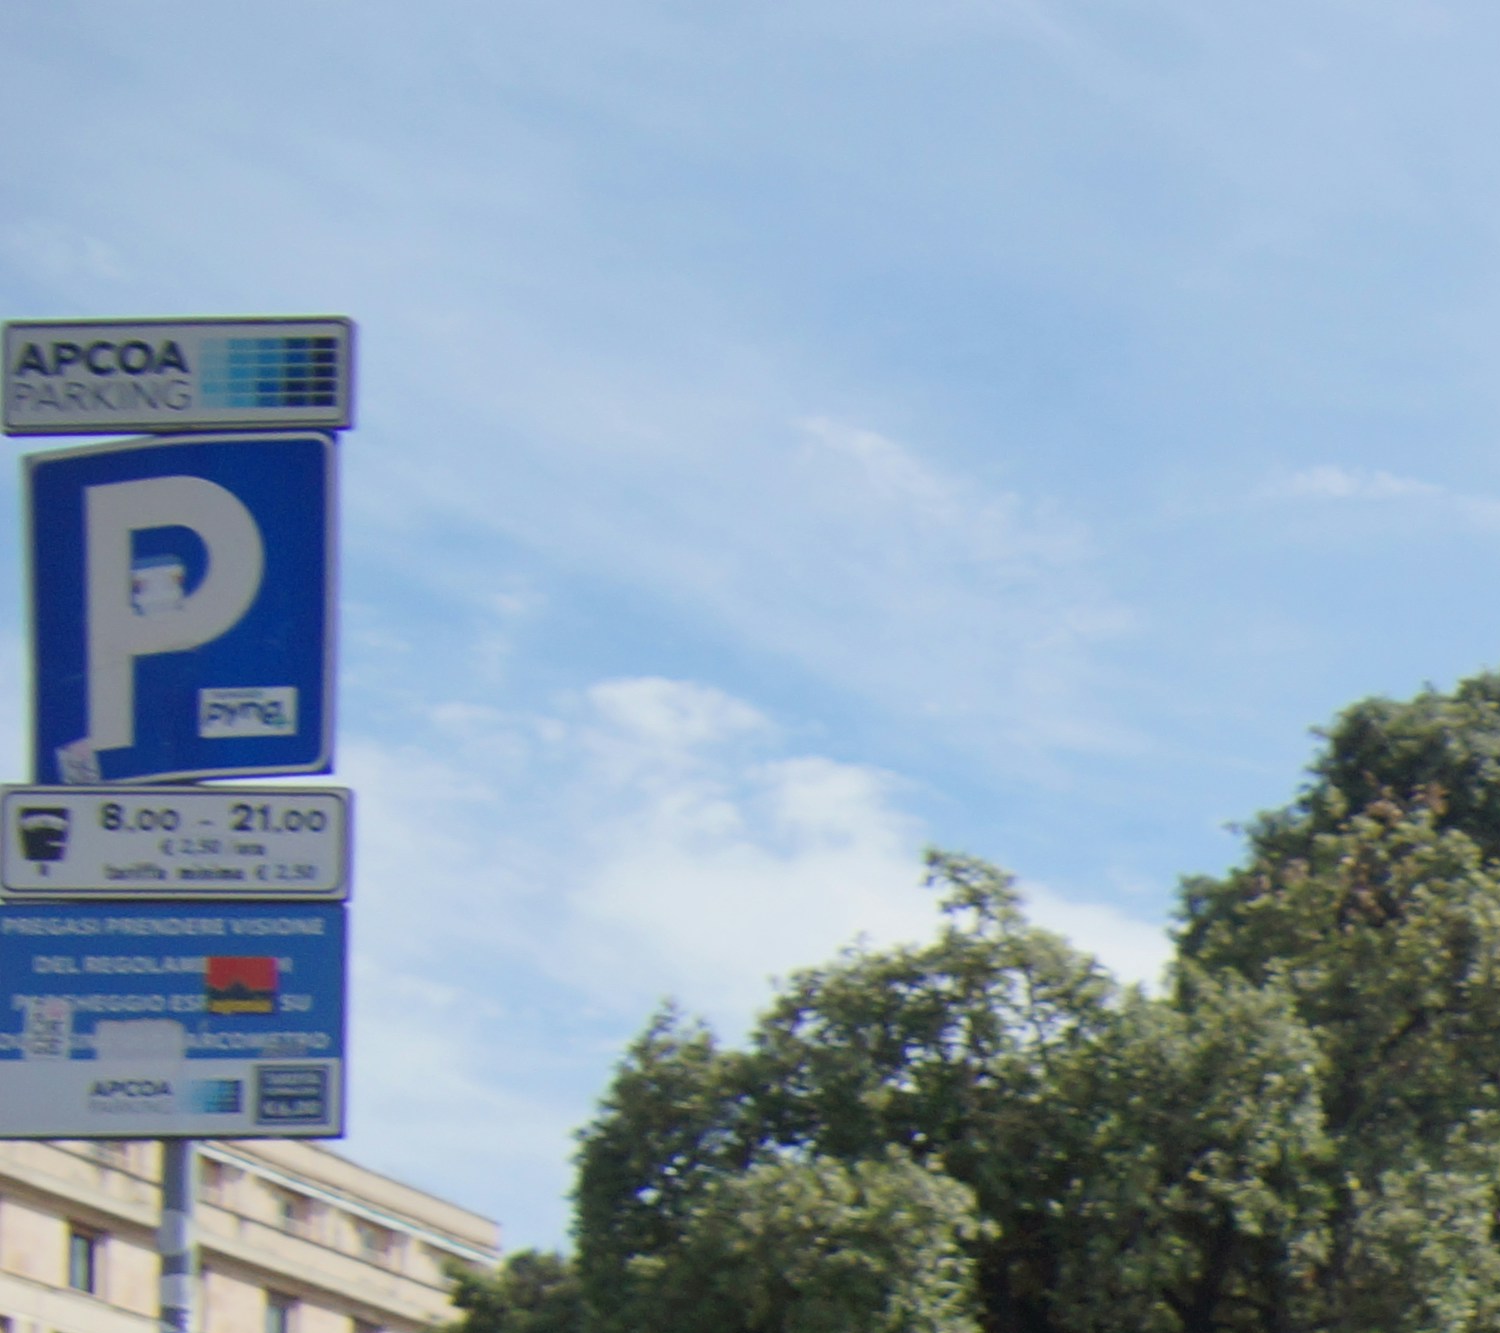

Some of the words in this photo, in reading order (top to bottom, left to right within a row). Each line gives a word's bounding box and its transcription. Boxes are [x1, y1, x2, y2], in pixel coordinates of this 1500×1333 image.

[17, 339, 189, 375] APCOA
[14, 380, 192, 411] PARKING
[99, 802, 181, 832] 8.00
[230, 803, 327, 833] 21.00
[103, 917, 227, 936] PRENDERE
[230, 917, 325, 936] VISIONE
[32, 955, 81, 974] DEL
[279, 994, 312, 1012] SU
[90, 1077, 173, 1097] APCOA
